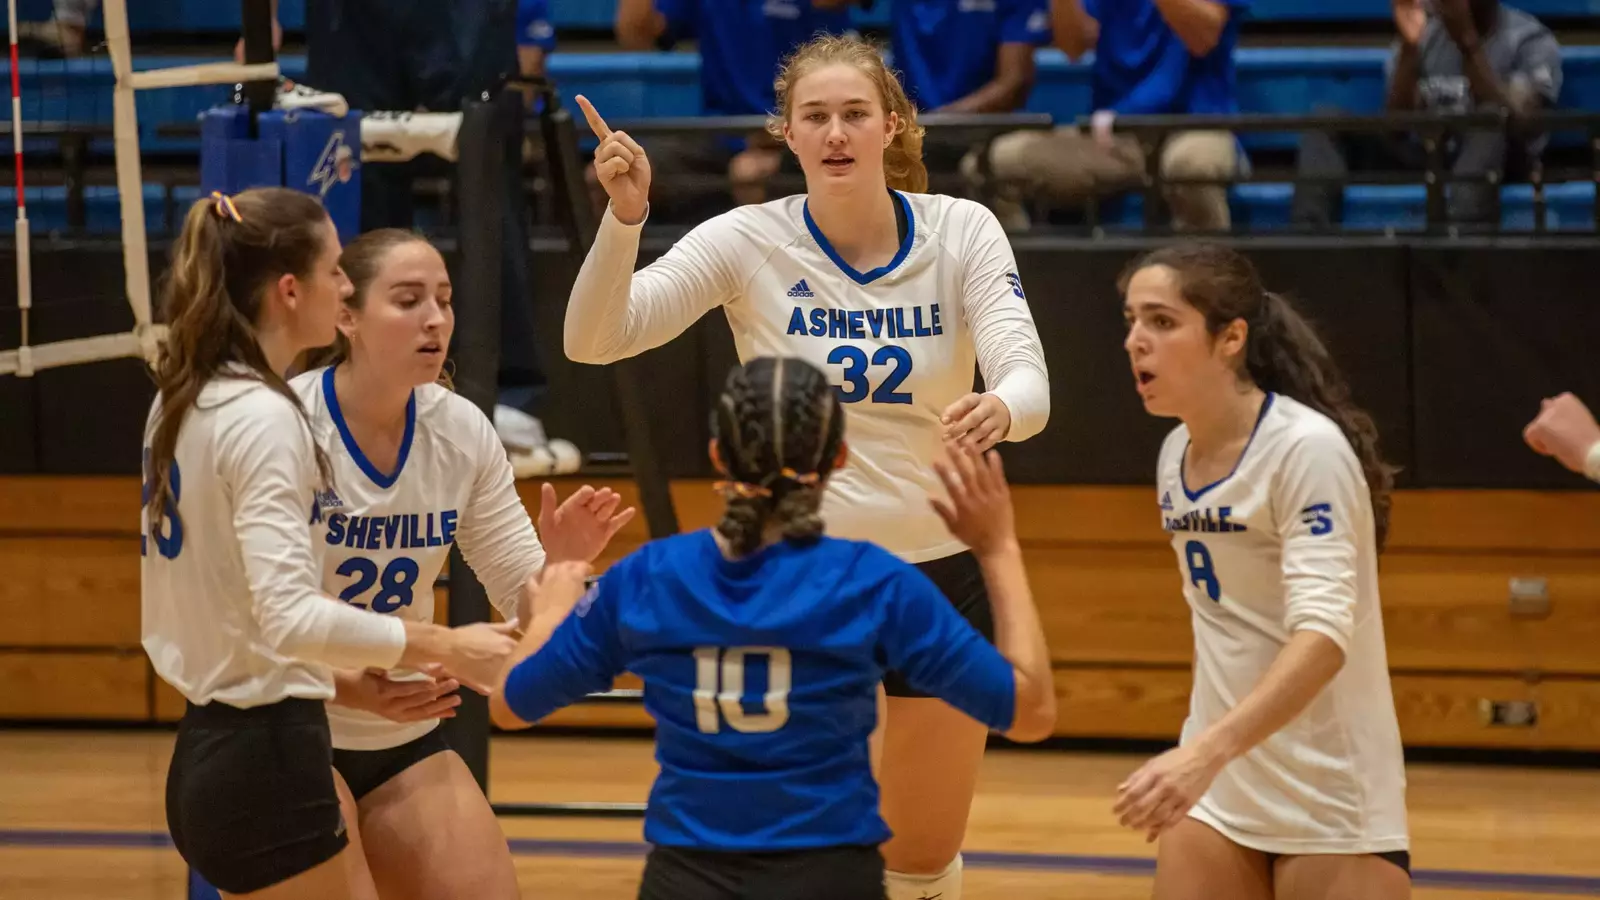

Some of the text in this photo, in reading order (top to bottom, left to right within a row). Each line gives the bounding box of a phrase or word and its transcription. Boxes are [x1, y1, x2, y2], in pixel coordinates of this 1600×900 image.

[786, 303, 943, 339] ASHEVILLE
[787, 290, 814, 298] adidas
[827, 345, 913, 405] 32
[336, 556, 420, 613] 28
[692, 645, 792, 734] 10
